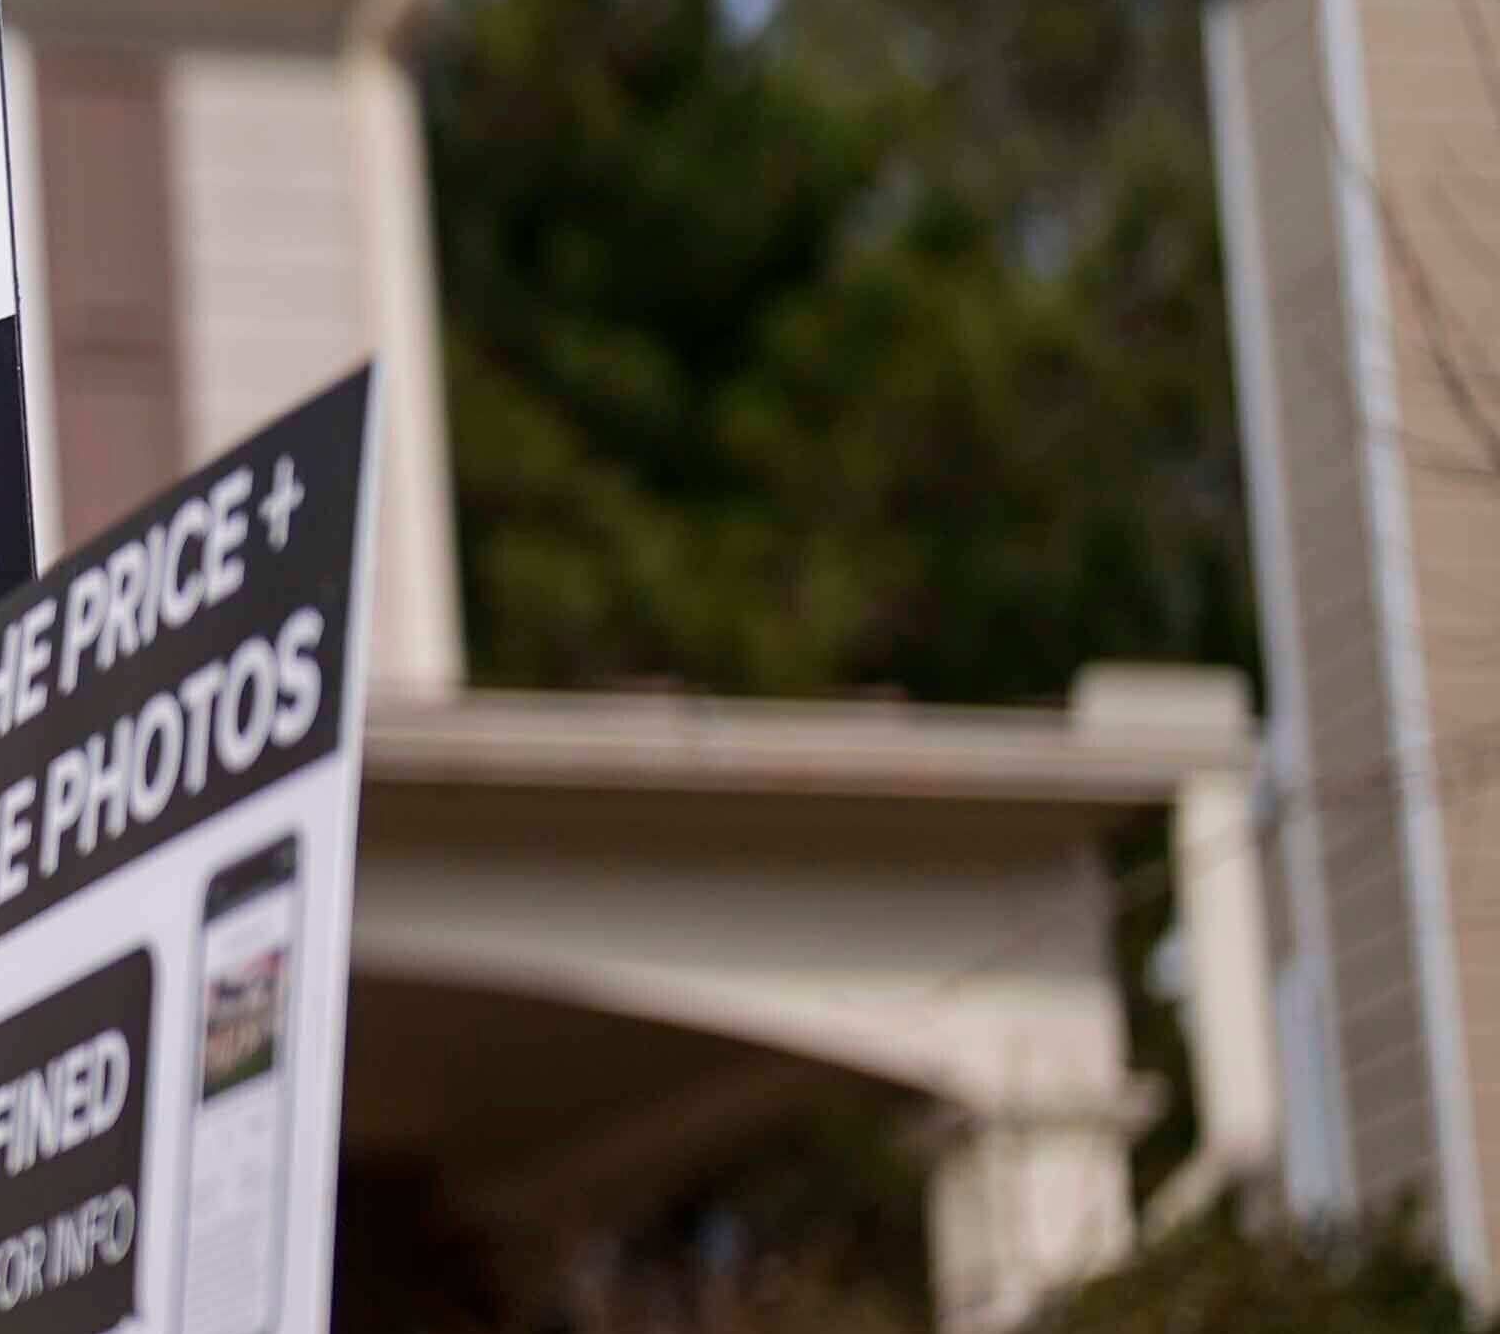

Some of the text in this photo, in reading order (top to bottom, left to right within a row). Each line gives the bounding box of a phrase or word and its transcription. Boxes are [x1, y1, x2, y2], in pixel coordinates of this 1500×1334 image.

[58, 466, 254, 695] PRICE
[257, 452, 304, 552] +
[38, 605, 326, 879] PHOTOS
[46, 1184, 137, 1290] INFO
